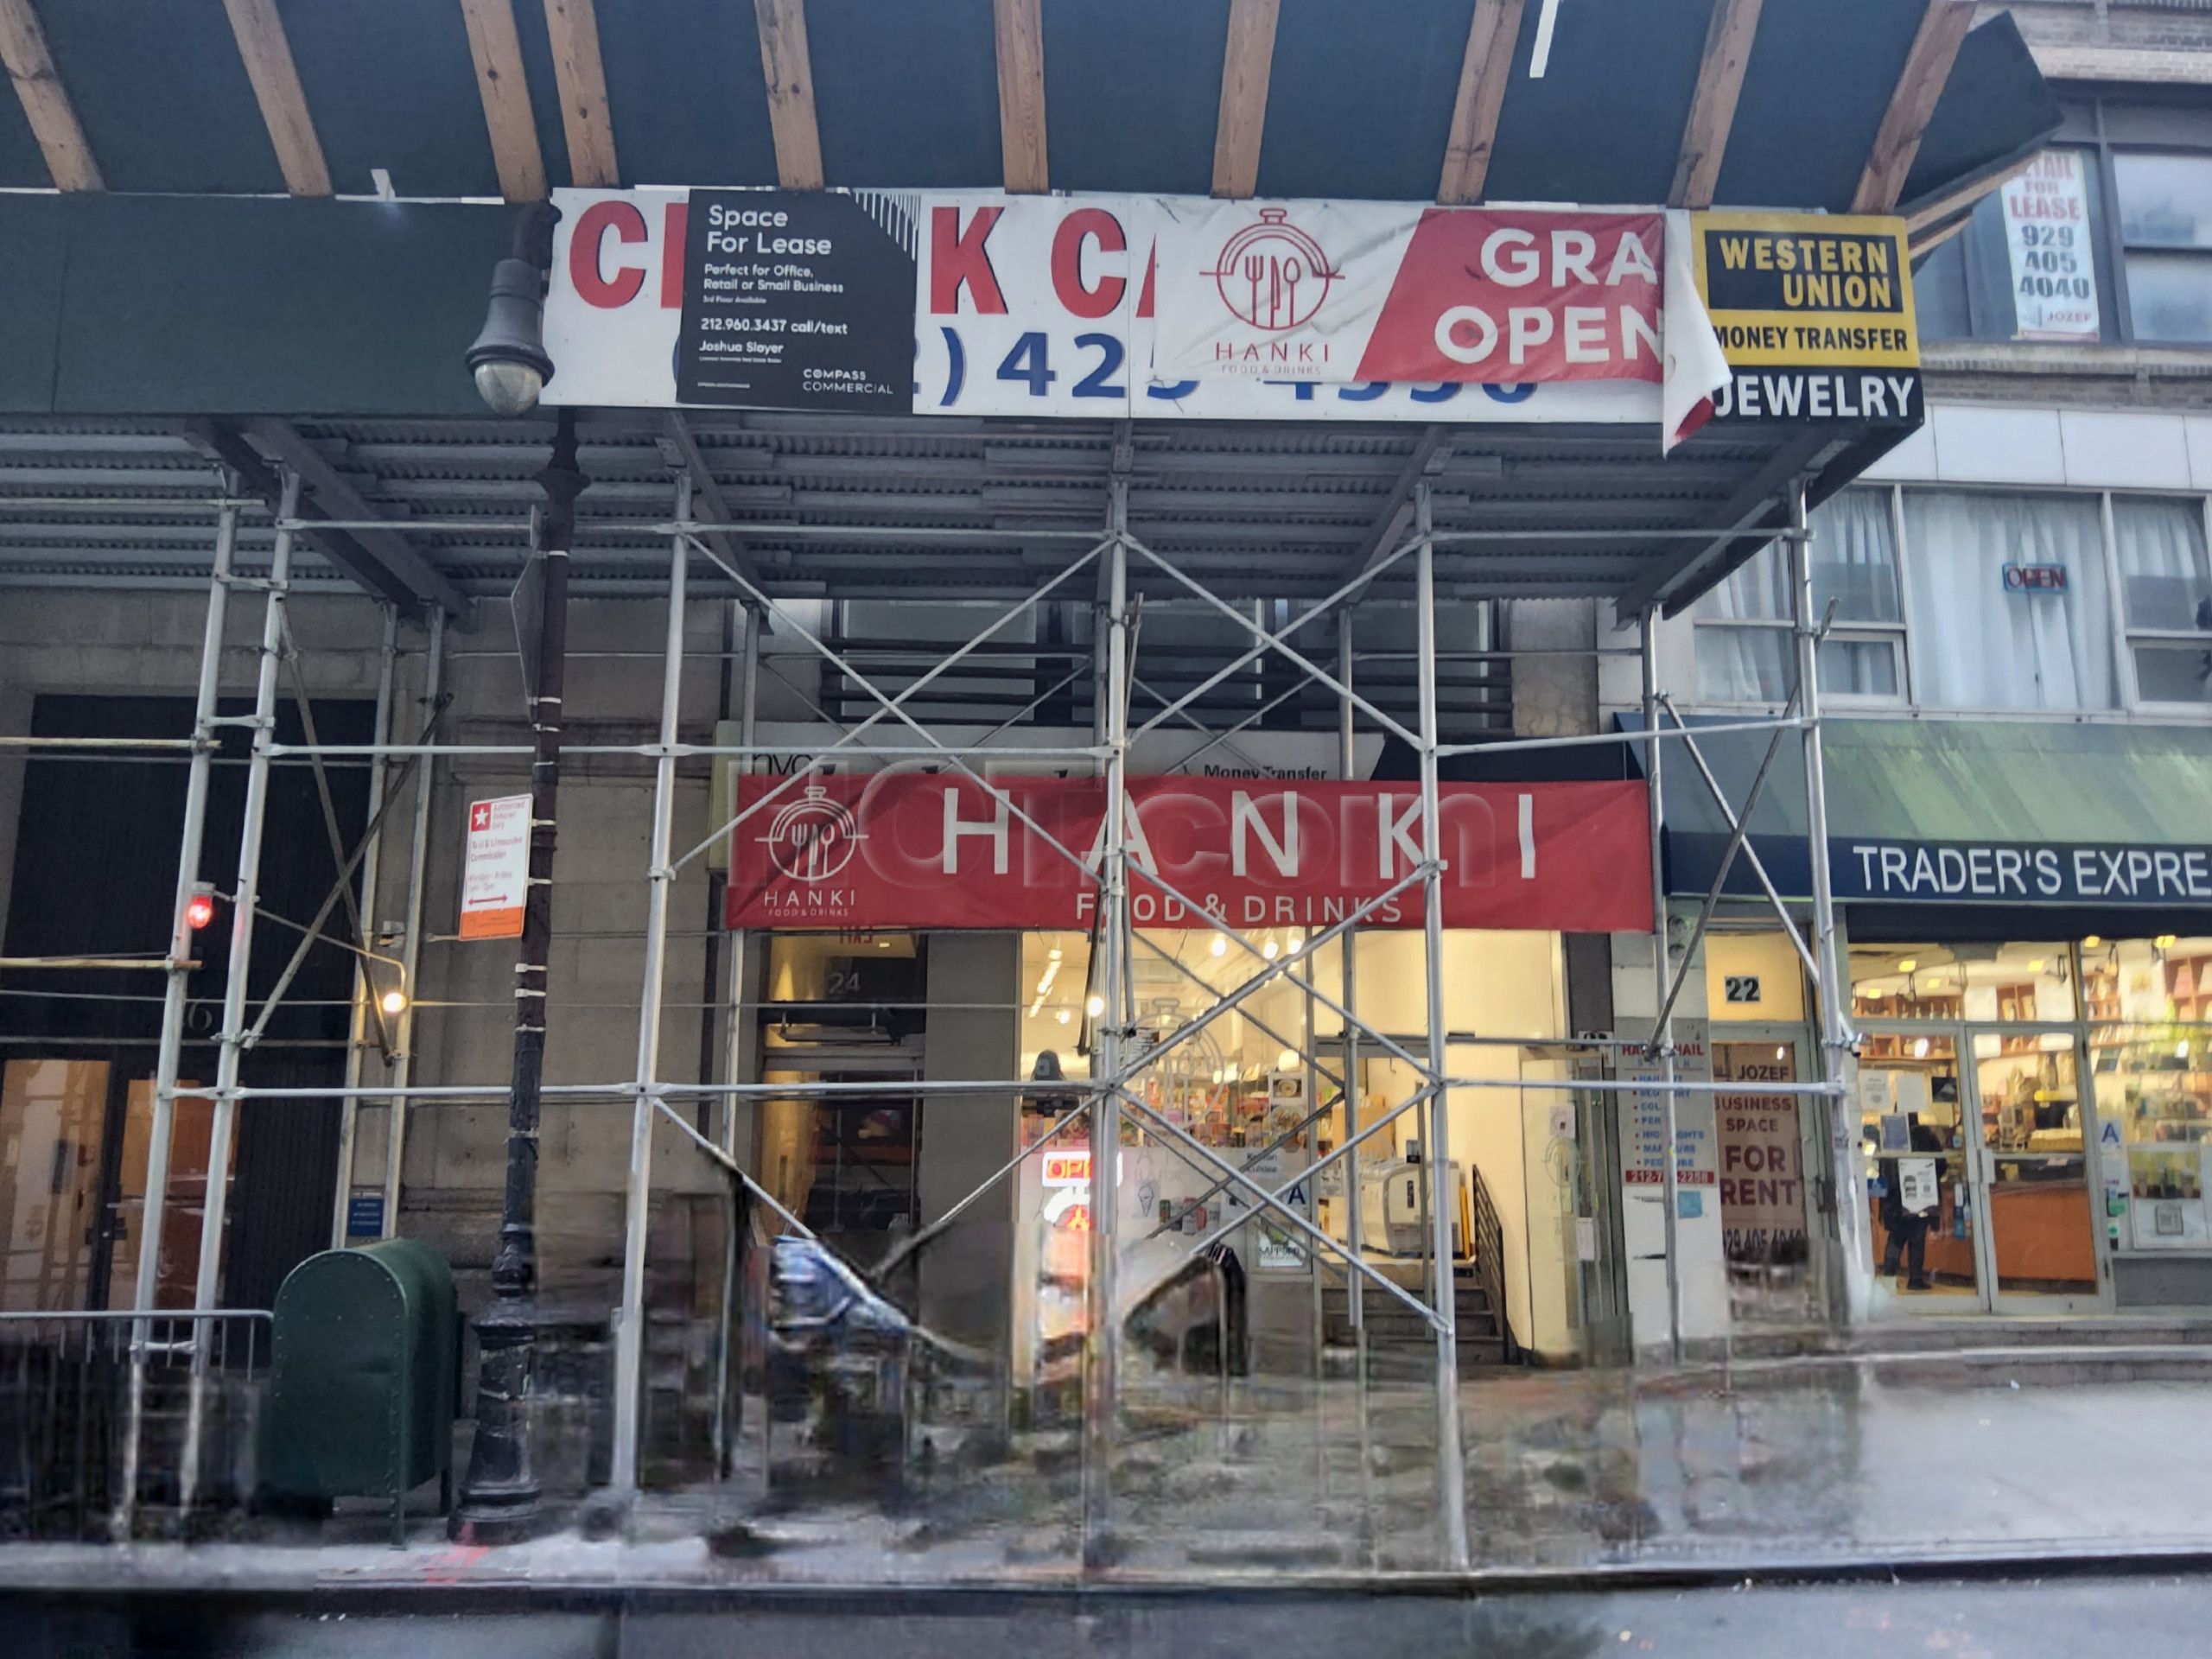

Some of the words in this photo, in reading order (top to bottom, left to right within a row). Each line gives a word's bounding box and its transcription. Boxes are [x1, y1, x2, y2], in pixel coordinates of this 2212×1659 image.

[709, 204, 789, 231] Space
[2010, 194, 2081, 221] LEASE
[707, 231, 749, 253] For
[757, 232, 832, 256] Lease
[2022, 225, 2074, 248] 929
[1481, 228, 1658, 288] GRA
[1719, 237, 1889, 274] WESTERN
[2025, 251, 2077, 273] 405
[704, 264, 748, 276] Perfect
[753, 264, 770, 276] for
[773, 265, 814, 278] Office,
[703, 278, 738, 289] Retail
[741, 281, 753, 290] or
[758, 279, 791, 291] Small
[793, 280, 844, 294] Business
[1783, 274, 1891, 308] UNION
[2019, 276, 2090, 299] 4040
[701, 317, 787, 332] 212.960.3437
[791, 319, 849, 334] call/text
[2047, 311, 2092, 323] JOZEF
[1434, 304, 1664, 365] OPEN
[1712, 325, 1789, 349] MONEY
[1795, 327, 1908, 352] TRANSFER
[699, 340, 742, 353] Joshua
[1217, 341, 1329, 362] HANKI
[804, 369, 866, 380] COMPASS
[1221, 365, 1258, 375] FOOD
[1262, 365, 1269, 374] &
[1274, 365, 1322, 376] DRINKS
[803, 381, 893, 395] COMMERCIAL
[1714, 374, 1914, 416] JEWELRY
[2007, 567, 2066, 589] OPEN
[1205, 765, 1260, 779] Money
[1263, 766, 1327, 781] Transfer
[943, 787, 1535, 879] HANKI
[1853, 846, 2063, 895] TRADER'S
[2074, 850, 2212, 897] EXPRE
[765, 890, 855, 907] HANKI
[1205, 894, 1227, 923] &
[1244, 895, 1402, 924] DRINKS
[810, 908, 849, 917] DRINKS
[830, 972, 861, 994] 24
[1726, 977, 1761, 1001] 22
[1738, 1064, 1789, 1081] JOZEF
[1714, 1096, 1793, 1112] BUSINESS
[1726, 1117, 1779, 1133] SPACE
[2101, 1122, 2120, 1142] A
[1725, 1145, 1786, 1173] FOR
[1287, 1180, 1306, 1205] A
[1719, 1178, 1796, 1206] RENT
